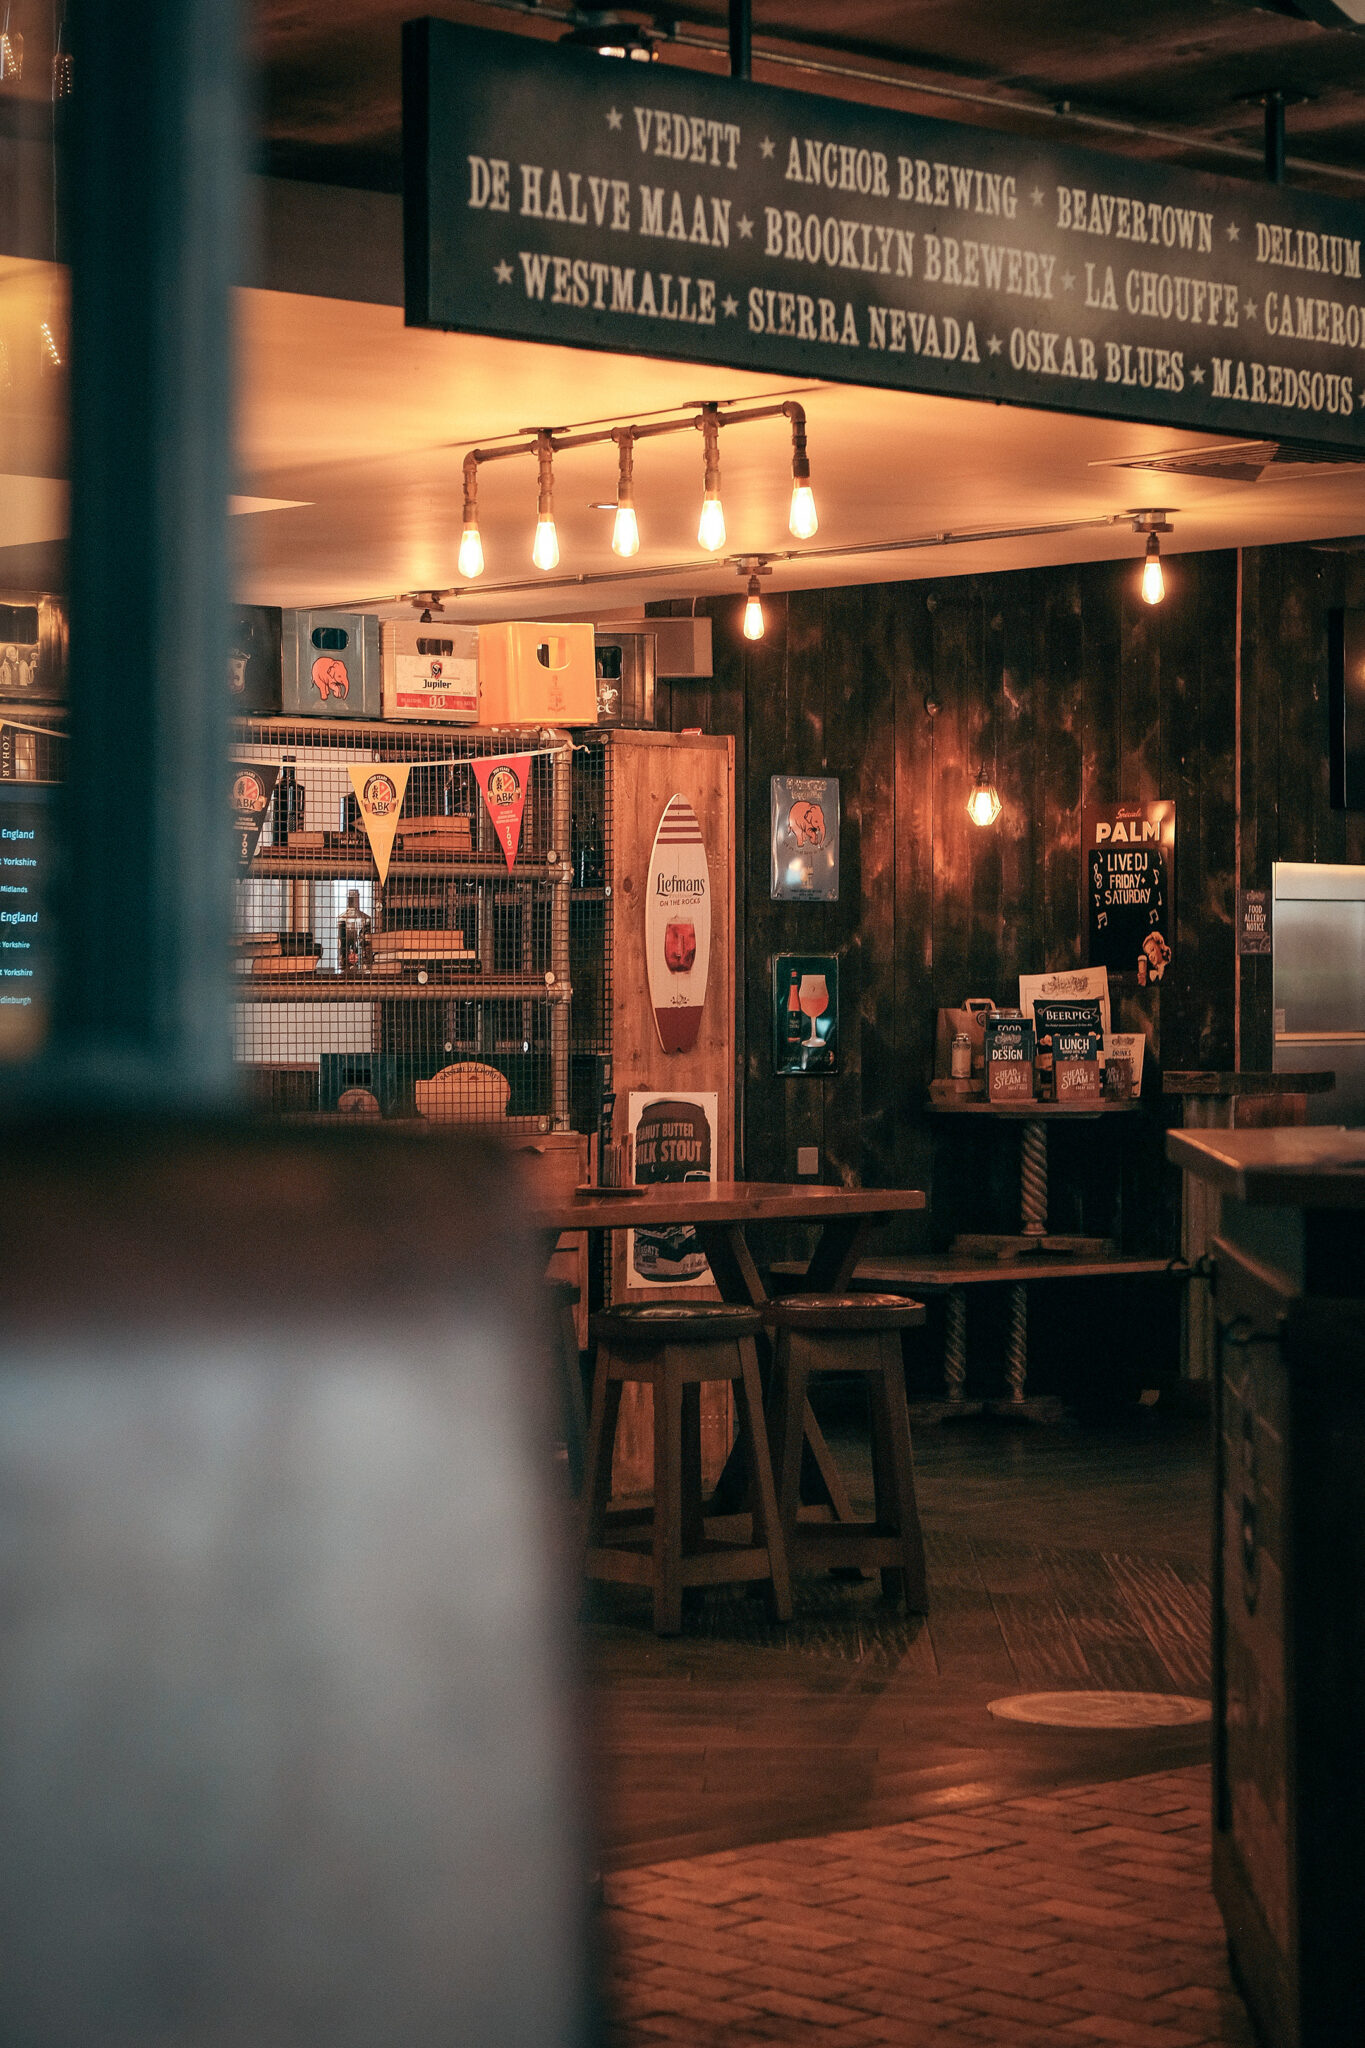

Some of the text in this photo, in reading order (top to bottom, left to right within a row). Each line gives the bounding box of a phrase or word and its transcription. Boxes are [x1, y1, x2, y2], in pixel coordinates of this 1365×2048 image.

[633, 107, 1361, 278] VEDETT ANCHOR BREWING BEAVERTOWN DELIRIUM
[468, 155, 1365, 349] DE HALVE MAAN BROOKLYN BREWERY LA CHOUFFE CAMERO
[518, 252, 1353, 415] WESTMALLE SIERRA NEVADA OSKAR BLUES MAREDSOUS
[423, 679, 452, 690] Jupiler
[235, 798, 256, 810] ABK
[496, 793, 514, 803] ABK
[372, 801, 389, 811] ABK
[1, 828, 34, 840] England
[1096, 821, 1160, 843] PALM
[3, 857, 37, 866] Yorkshire
[1107, 852, 1148, 872] LIVE DJ
[656, 873, 705, 896] Liefmans
[1109, 873, 1141, 889] FRIDAY
[0, 885, 28, 893] Midlands
[1104, 888, 1151, 905] SATURDAY
[1248, 904, 1263, 914] FOOD
[1, 912, 38, 925] England
[1244, 913, 1267, 923] ALLERGY
[1246, 922, 1265, 932] NOTICE
[2, 941, 30, 949] Yorkshire
[3, 968, 33, 976] Yorkshire
[1046, 1010, 1091, 1021] BEERPIG
[1060, 1038, 1090, 1050] LUNCH
[992, 1049, 1023, 1060] DESIGN
[1000, 1068, 1018, 1078] HEAD
[1067, 1068, 1085, 1077] HEAD
[994, 1075, 1021, 1089] STEAM
[1061, 1075, 1089, 1089] STEAM
[662, 1122, 694, 1137] BUTTER
[661, 1140, 702, 1162] STOUT
